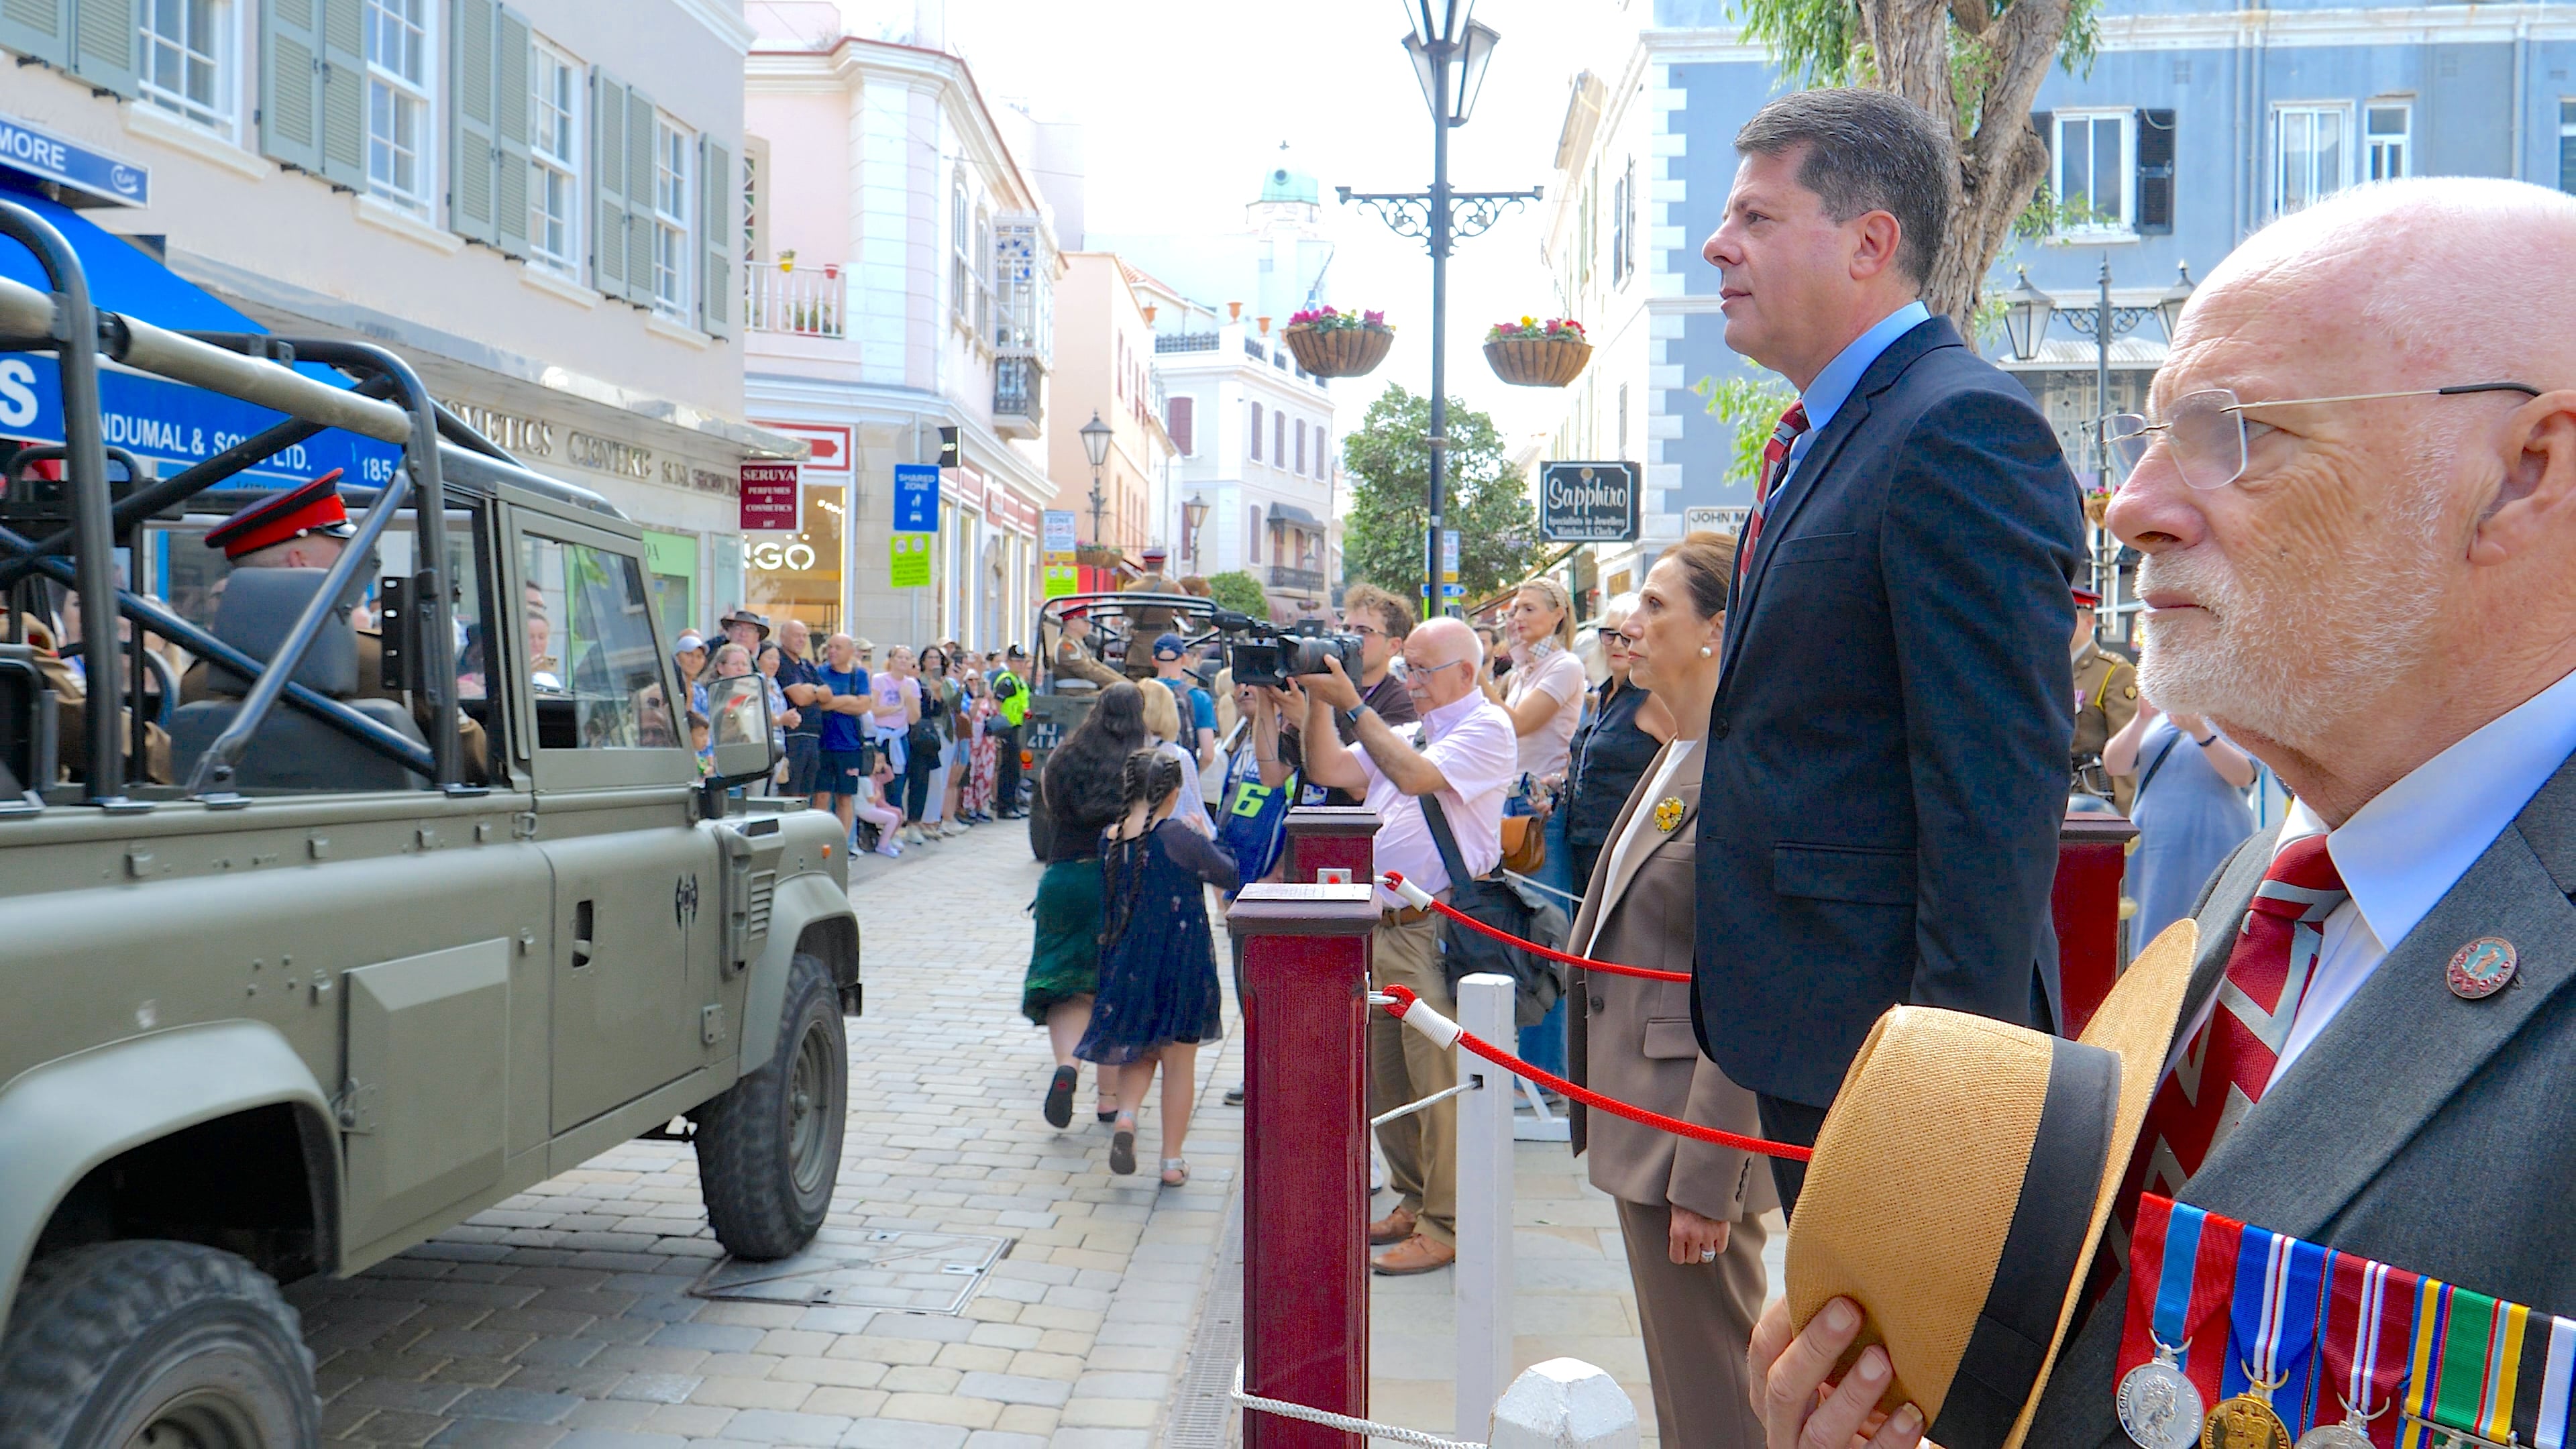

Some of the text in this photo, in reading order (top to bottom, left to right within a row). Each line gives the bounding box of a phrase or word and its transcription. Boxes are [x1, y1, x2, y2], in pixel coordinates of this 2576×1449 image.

[191, 427, 205, 455] &
[743, 469, 796, 481] SERUYA
[898, 474, 936, 483] SHARED
[904, 482, 928, 491] ZONE
[1548, 477, 1627, 516] Sapphiro
[1691, 512, 1730, 523] JOHN
[1232, 782, 1272, 818] 6
